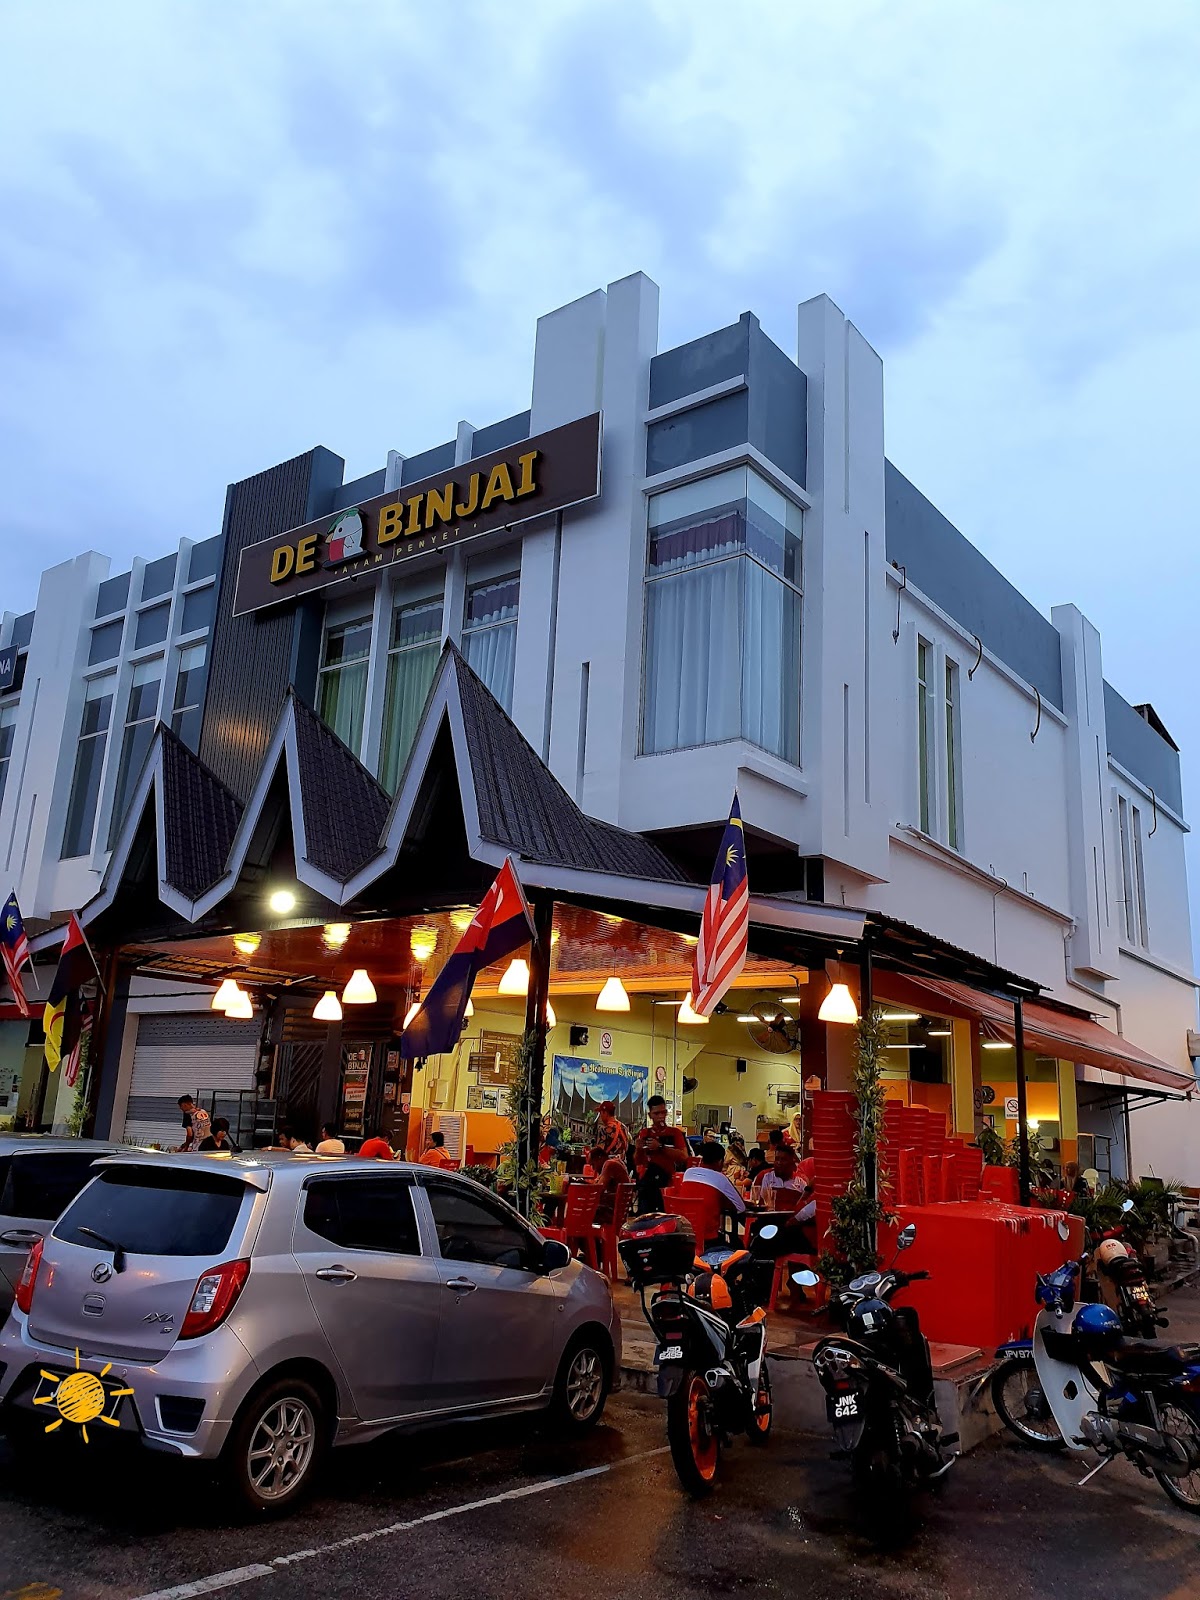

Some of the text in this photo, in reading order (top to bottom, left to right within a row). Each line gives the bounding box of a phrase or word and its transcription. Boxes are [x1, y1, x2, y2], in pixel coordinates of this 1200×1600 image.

[270, 451, 538, 583] DE BINJAI
[342, 527, 460, 573] AYAM PENYET
[347, 1061, 368, 1070] BINJA
[835, 1394, 857, 1408] JNK
[835, 1404, 858, 1418] 642
